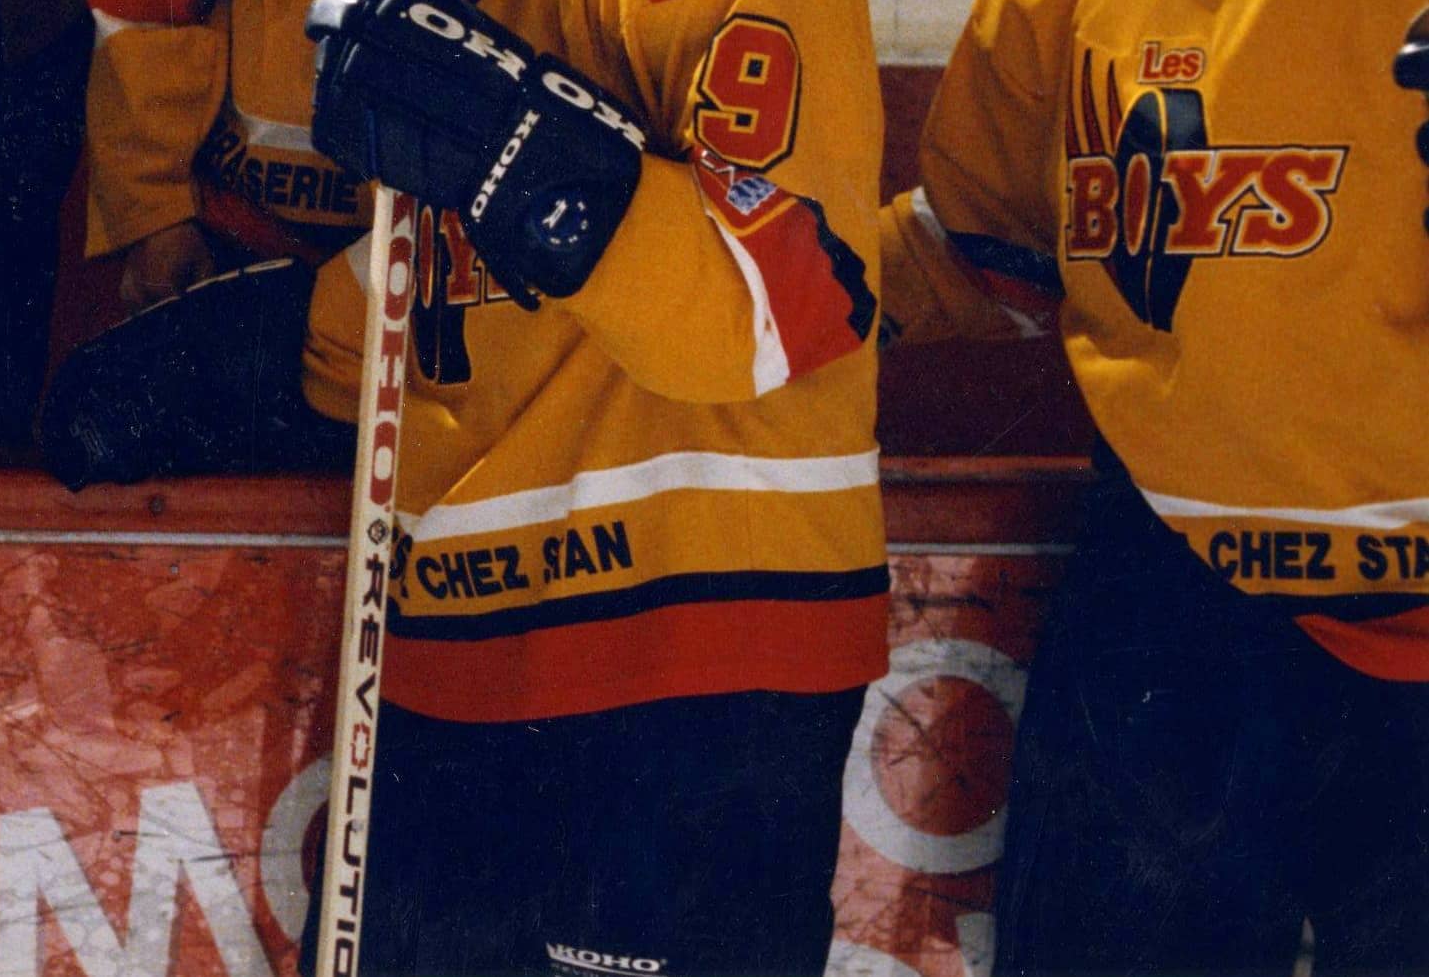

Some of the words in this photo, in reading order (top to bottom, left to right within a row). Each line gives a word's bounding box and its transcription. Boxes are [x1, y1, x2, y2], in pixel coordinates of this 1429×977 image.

[1137, 41, 1204, 85] Les
[694, 11, 801, 173] 9
[1066, 145, 1349, 261] BOYS
[415, 545, 529, 600] CHEZ
[1209, 531, 1336, 580] CHEZ
[555, 943, 660, 972] KOHO
